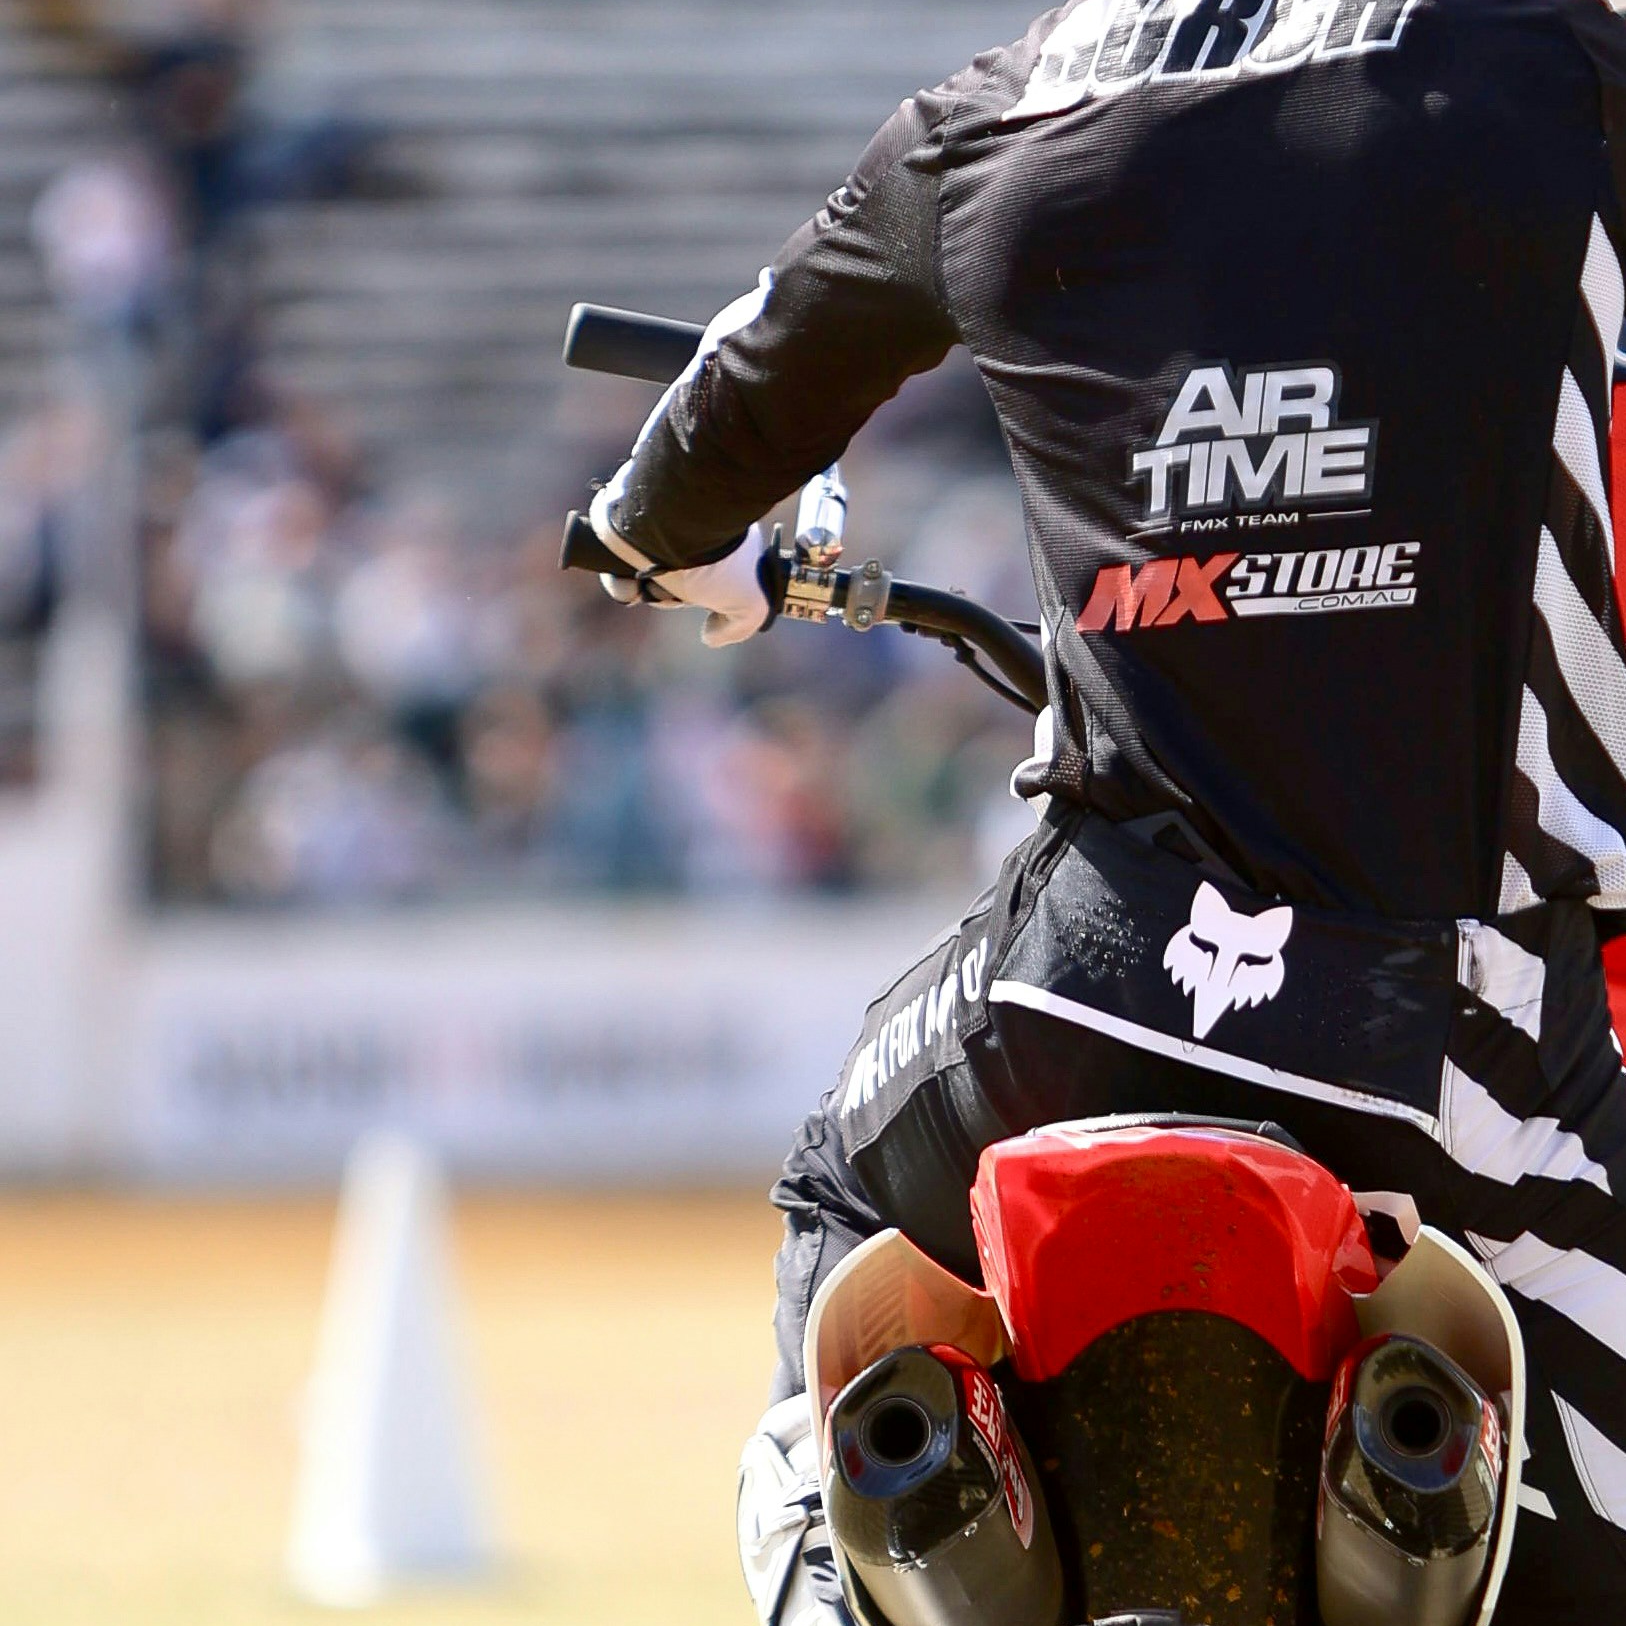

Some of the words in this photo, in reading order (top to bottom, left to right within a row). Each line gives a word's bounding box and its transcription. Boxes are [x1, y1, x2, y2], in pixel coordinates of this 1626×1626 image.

[1156, 366, 1334, 445] AIR
[1132, 428, 1369, 513] TIME
[1180, 518, 1229, 534] FMX
[1235, 511, 1299, 528] TEAM
